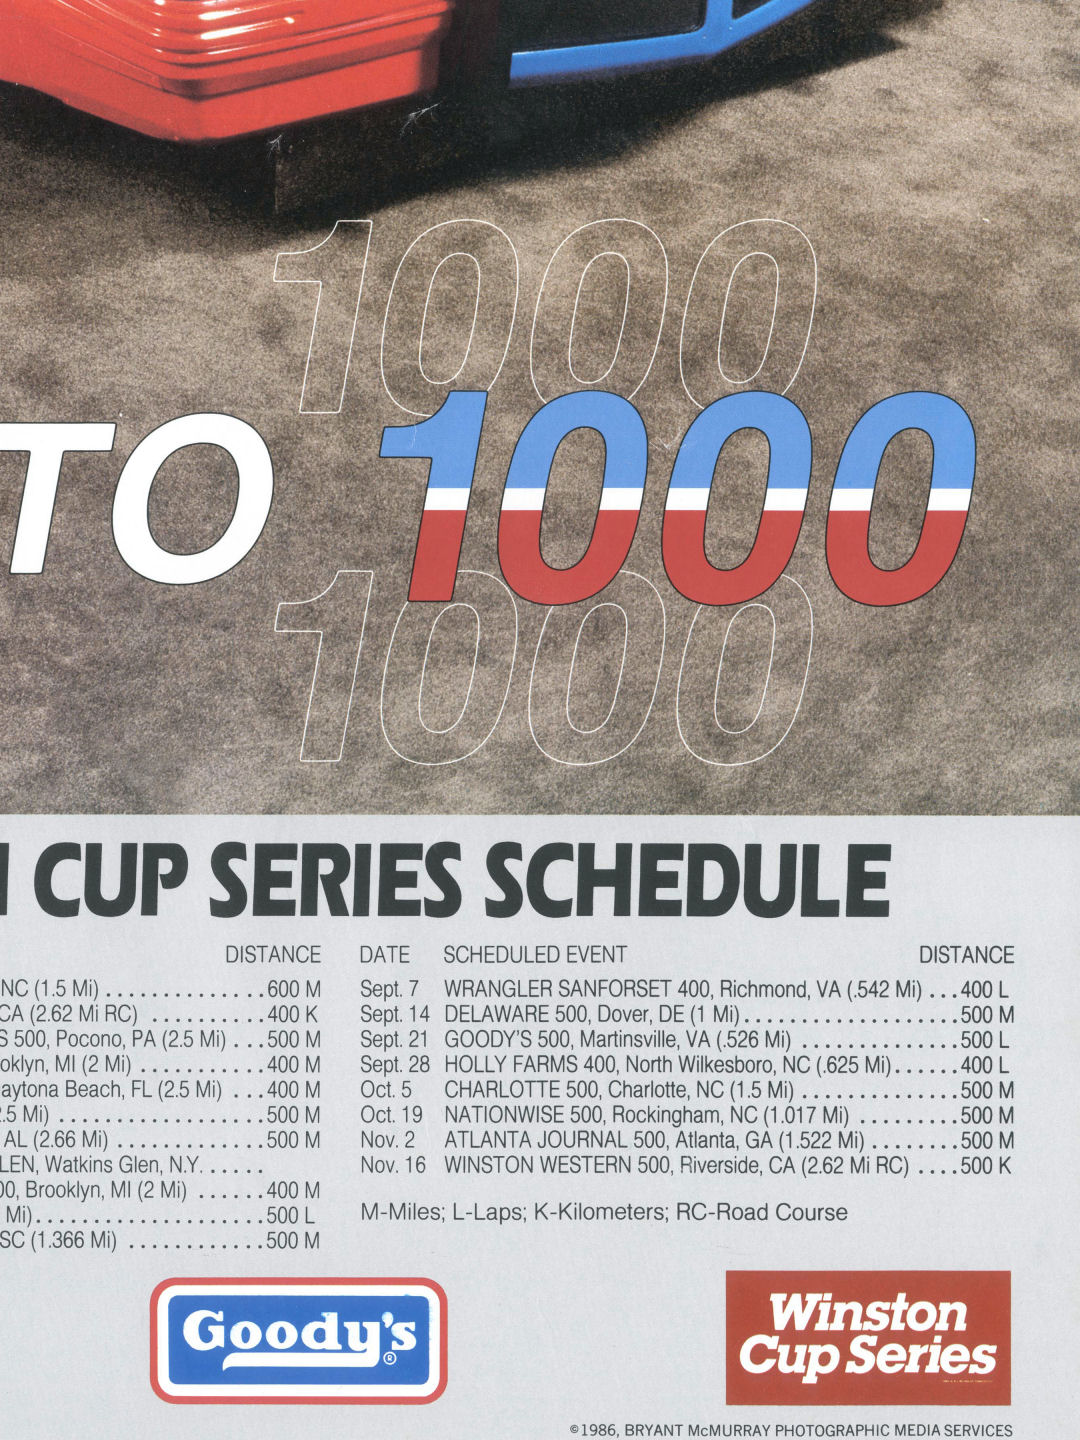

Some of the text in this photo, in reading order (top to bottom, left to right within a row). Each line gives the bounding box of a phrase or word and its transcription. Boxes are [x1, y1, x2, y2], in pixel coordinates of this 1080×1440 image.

[273, 217, 818, 415] 1000
[378, 389, 978, 605] 1000
[273, 567, 816, 767] 1000
[34, 842, 188, 918] CUP
[210, 842, 462, 918] SERIES
[485, 842, 892, 918] SCHEDULE
[226, 945, 321, 964] DISTANCE
[360, 945, 1014, 964] DATE SCHEDULED EVENT DISTANCE
[2, 978, 28, 997] NC
[34, 979, 66, 1002] (1.5
[73, 979, 98, 1002] Mi)
[268, 980, 300, 998] 600
[306, 980, 320, 998] M
[361, 1029, 1010, 1052] Sept. 21 GOODY'S 500, Martinsville, VA (.526 Mi) 500 L
[361, 1130, 1014, 1154] Nov. 2 ATLANTA JOURNAL 500, Atlanta, GA (1.522 Mi) 500 M
[45, 1155, 113, 1173] Watkins
[119, 1155, 163, 1176] Glen,
[170, 1156, 202, 1173] N.Y.
[362, 1202, 848, 1225] M-Miles; L-Laps; K-Kilometers; RC-Road Course
[770, 1292, 967, 1331] Winston
[182, 1308, 417, 1365] Goody's
[739, 1334, 997, 1384] Cup Series
[570, 1424, 1013, 1438] ©1986, BRYANT McMURRAY PHOTOGRAPHIC MEDIA SERVICES
